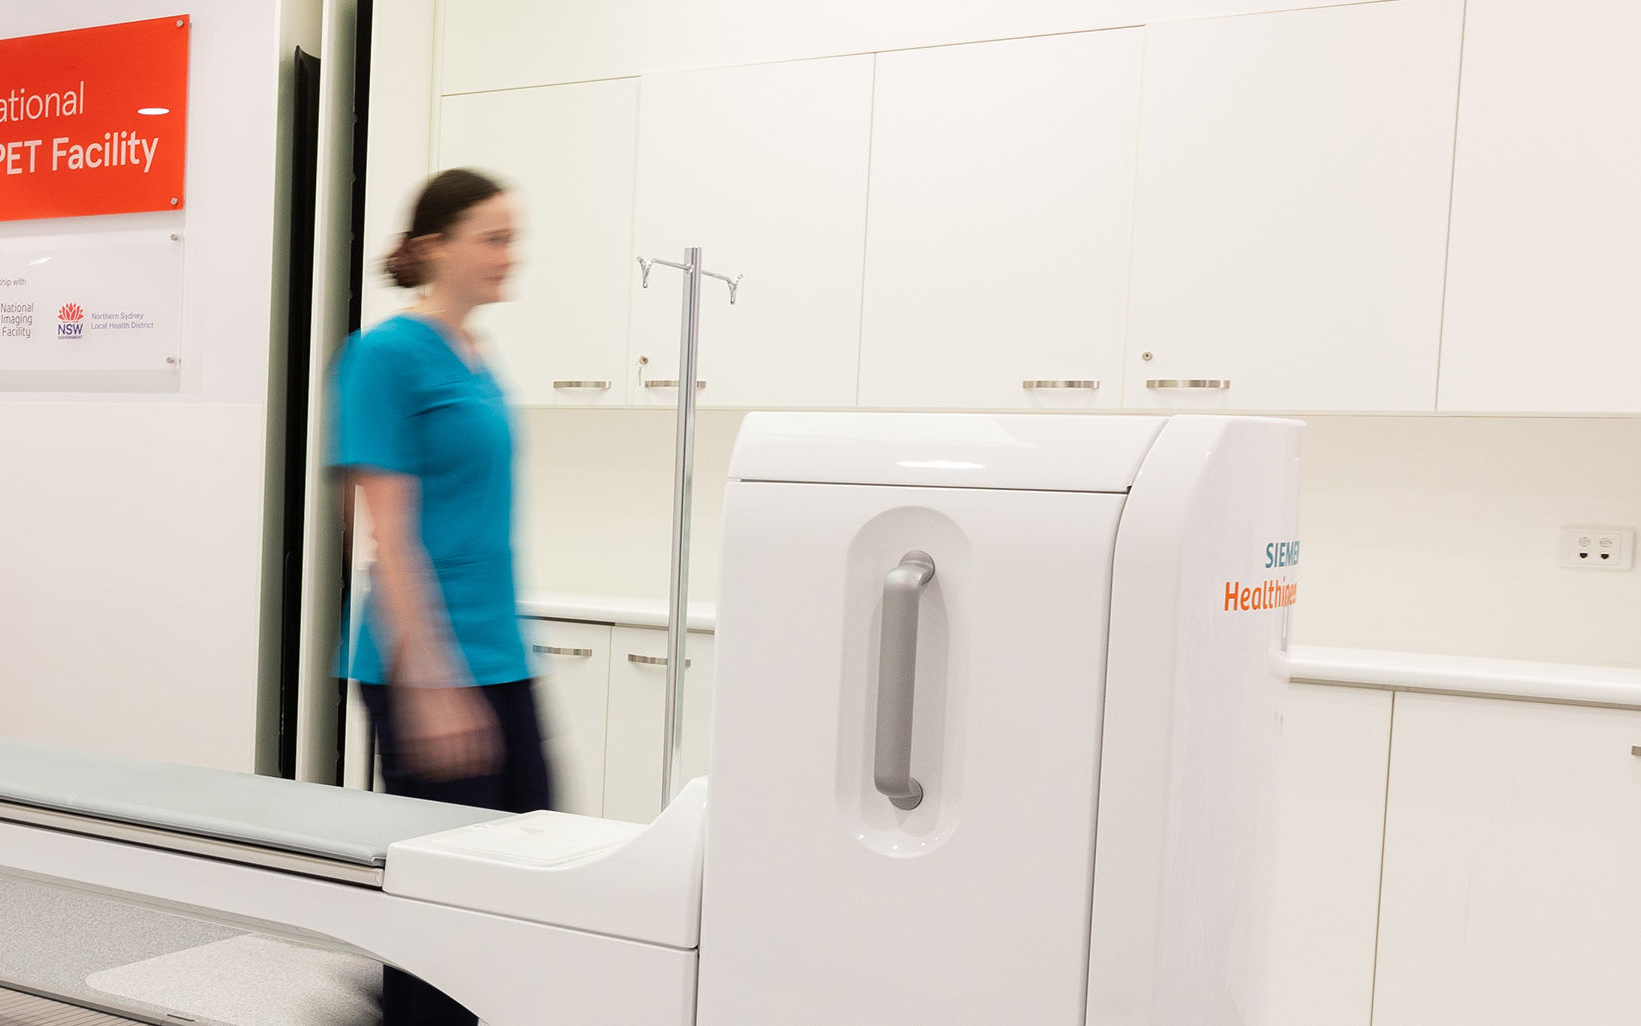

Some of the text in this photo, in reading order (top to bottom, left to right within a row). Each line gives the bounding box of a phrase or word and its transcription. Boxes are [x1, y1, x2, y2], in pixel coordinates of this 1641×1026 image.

[52, 130, 159, 173] Facility
[13, 277, 27, 286] with
[0, 303, 34, 313] National
[1, 314, 33, 326] Imaging
[120, 312, 144, 321] Sydney
[58, 323, 83, 335] NSW
[91, 321, 154, 330] Local Health District
[1, 326, 32, 339] Facility
[1265, 540, 1300, 569] SIEME
